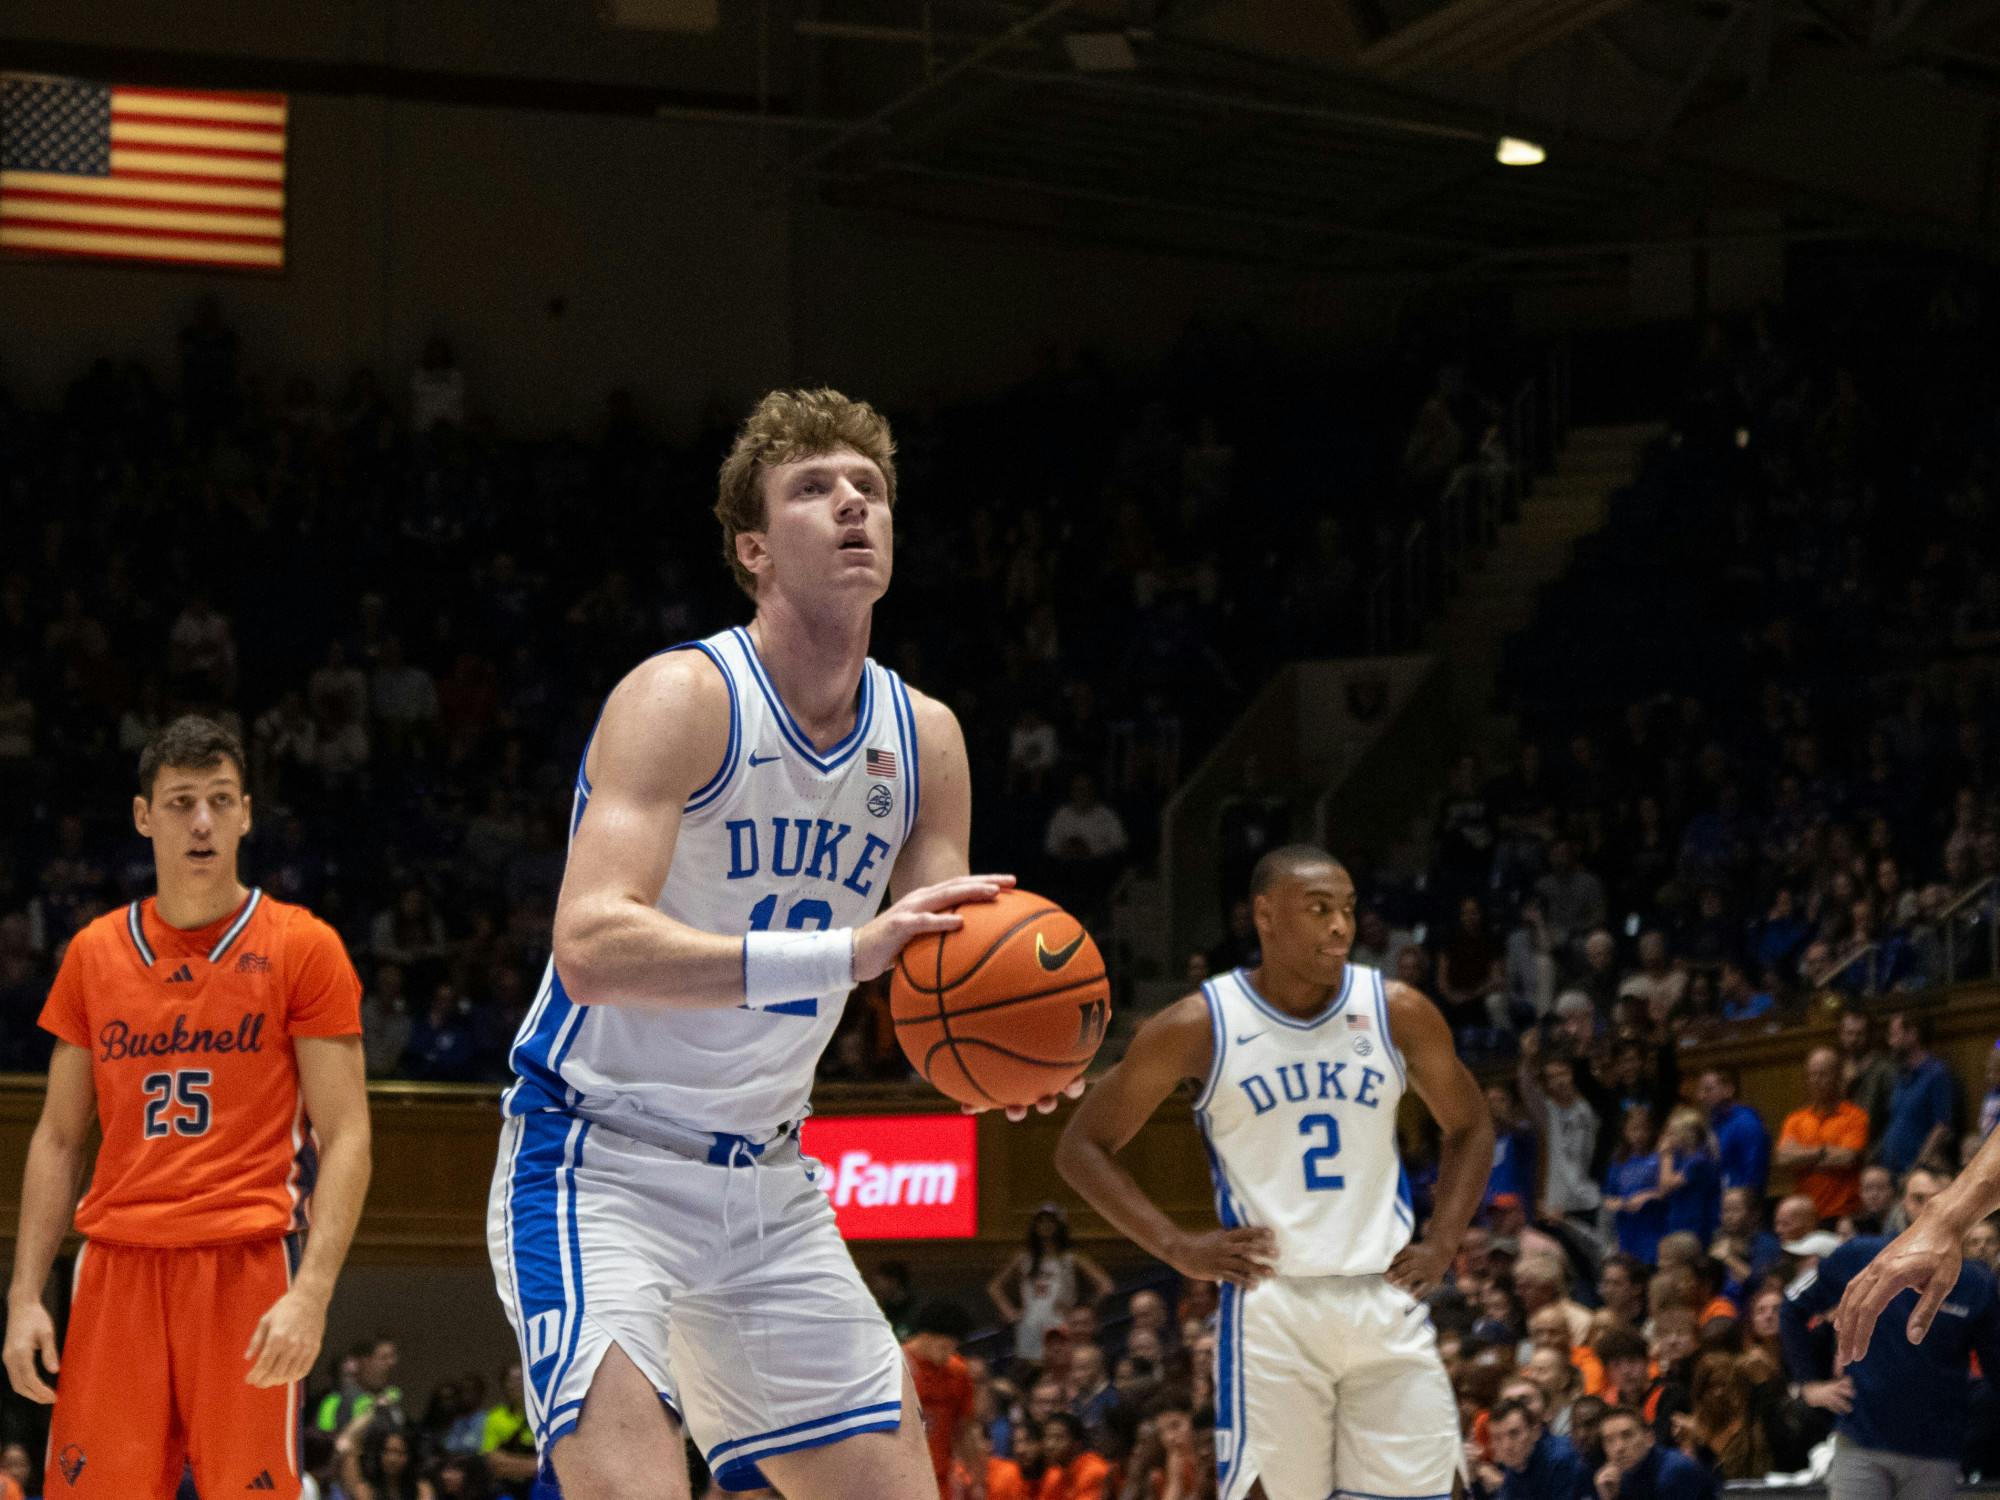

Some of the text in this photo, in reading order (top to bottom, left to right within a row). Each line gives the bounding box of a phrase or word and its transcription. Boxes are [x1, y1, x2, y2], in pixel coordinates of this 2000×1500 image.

[725, 817, 890, 897] DUKE
[100, 1012, 265, 1062] Bucknell
[143, 1067, 212, 1140] 25
[1239, 1061, 1385, 1115] DUKE
[1298, 1113, 1344, 1192] 2
